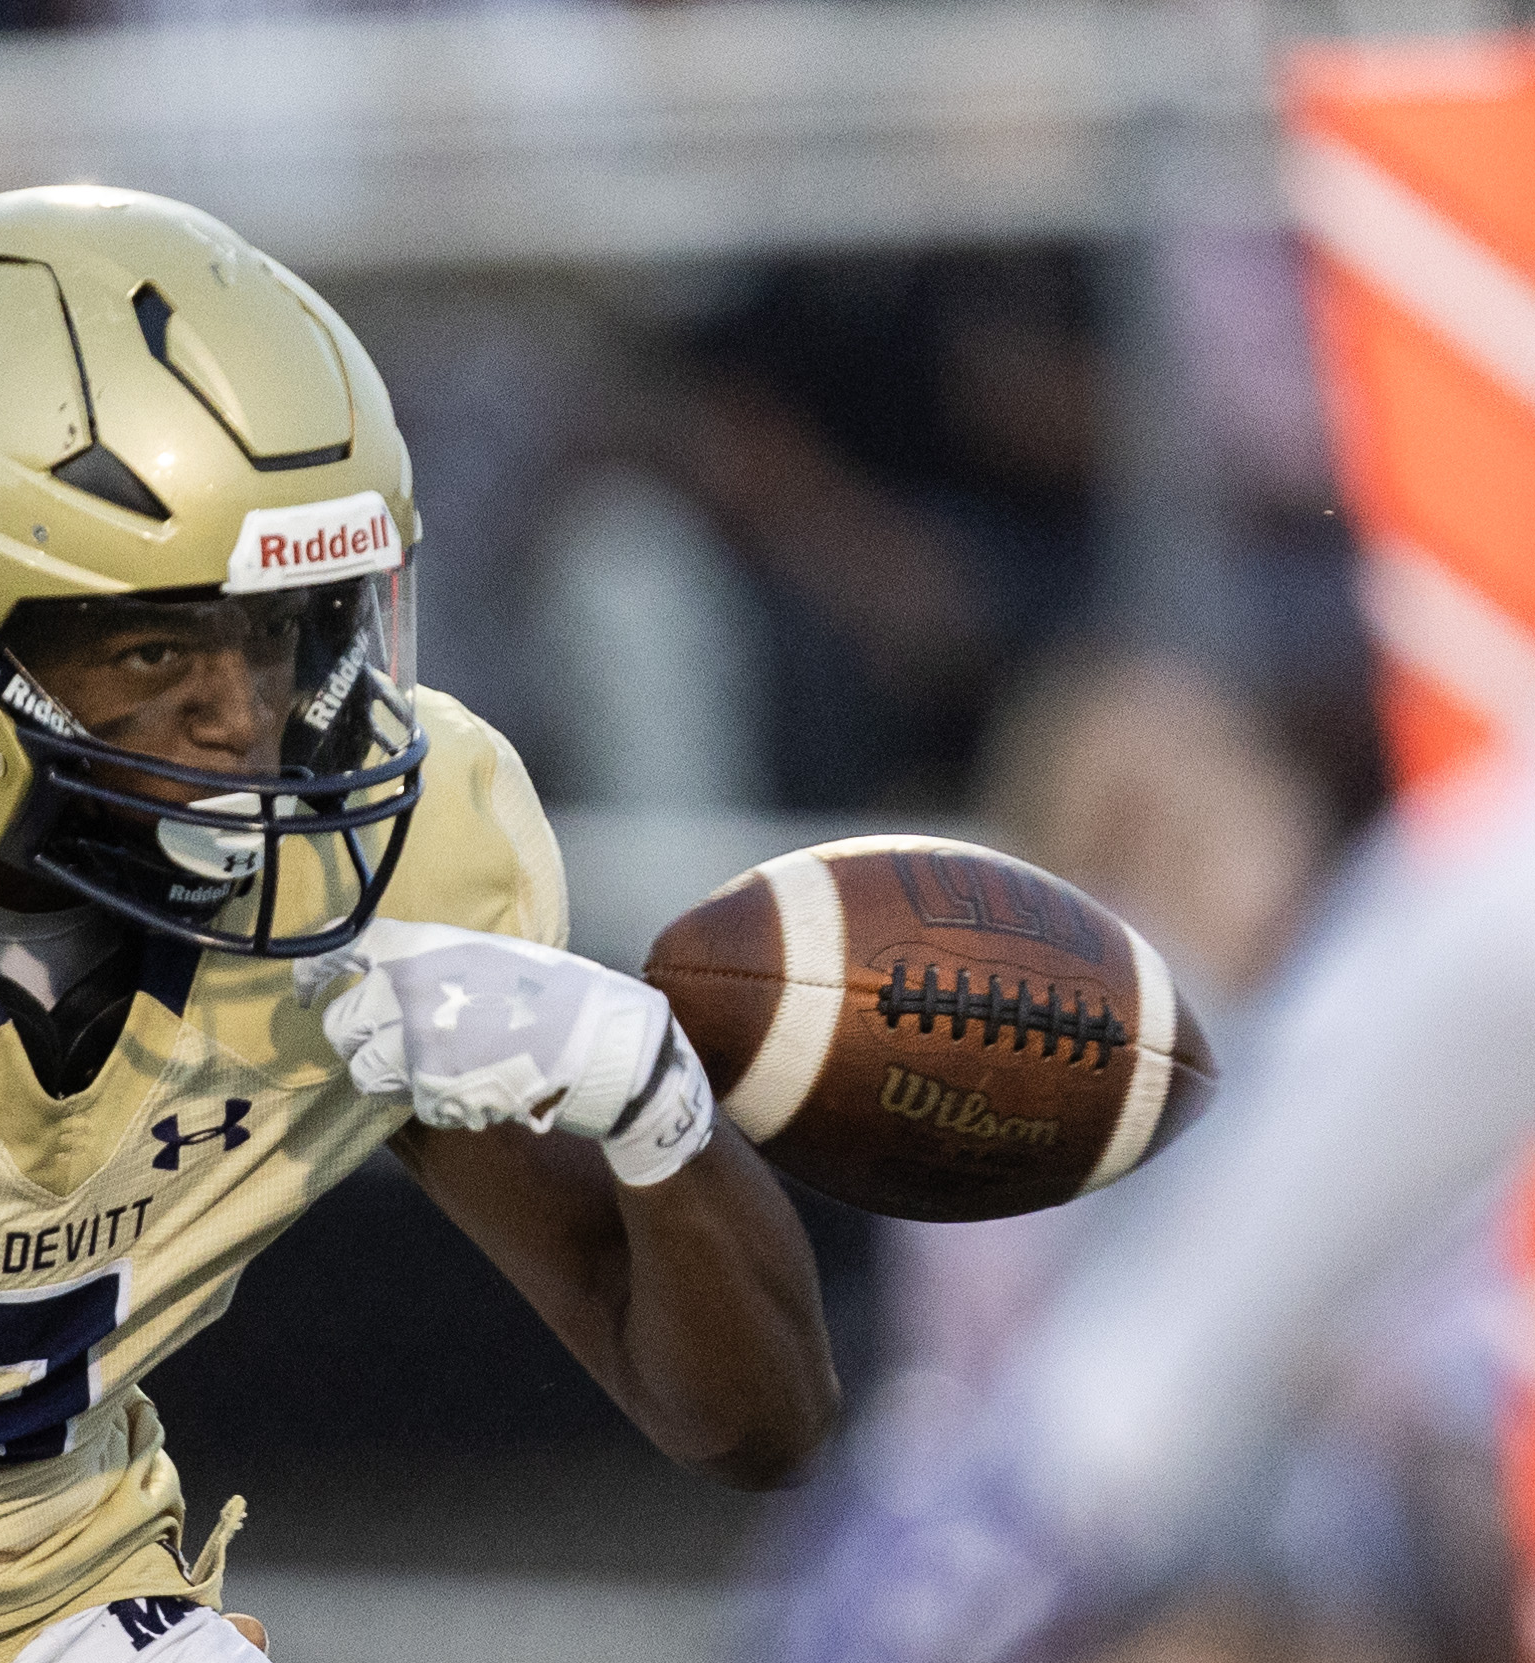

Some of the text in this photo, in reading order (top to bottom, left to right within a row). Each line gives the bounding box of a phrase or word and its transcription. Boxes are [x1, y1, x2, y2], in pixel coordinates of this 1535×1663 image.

[259, 515, 390, 569] Riddell
[1, 673, 88, 738] Ridd
[880, 1063, 1060, 1146] Wilson
